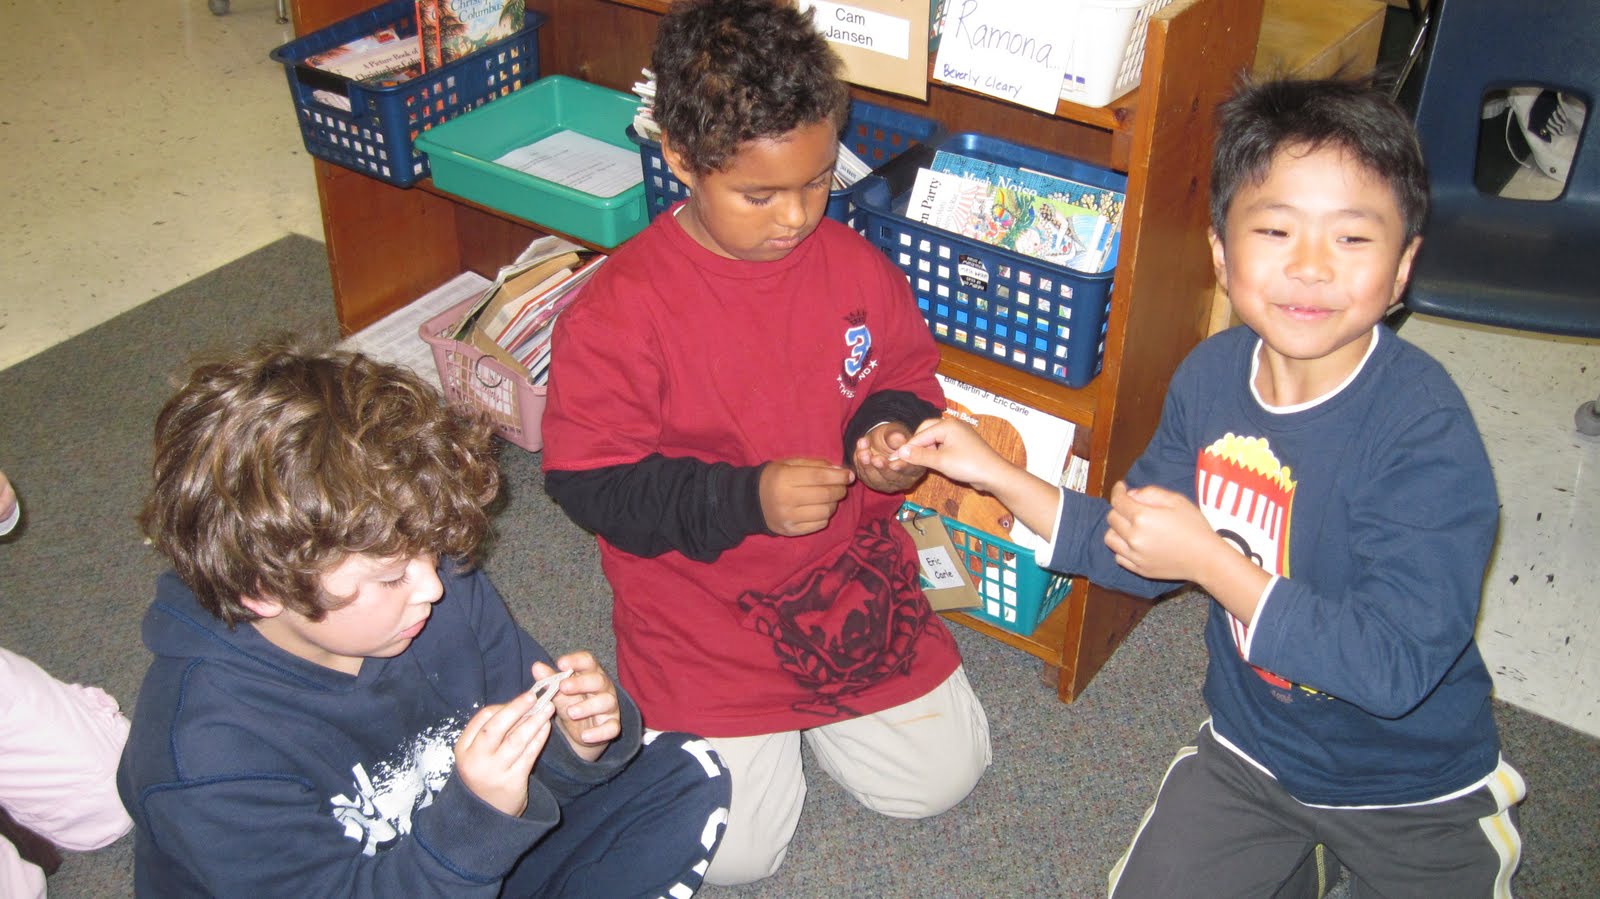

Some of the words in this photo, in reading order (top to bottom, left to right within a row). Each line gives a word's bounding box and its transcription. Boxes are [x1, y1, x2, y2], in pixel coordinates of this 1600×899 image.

[459, 3, 504, 23] Columbus
[835, 7, 866, 26] Cam
[826, 25, 873, 47] Jansen
[368, 56, 393, 68] Picture
[392, 51, 411, 61] Book
[943, 63, 980, 86] Beverly
[985, 76, 1023, 99] Cleary
[920, 177, 942, 210] Party
[962, 171, 992, 186] Much
[997, 175, 1038, 197] Noise
[844, 324, 872, 377] 3
[943, 376, 956, 385] Bill
[957, 381, 981, 396] Martin
[981, 391, 990, 399] Jr
[993, 394, 1008, 408] Eric
[1009, 402, 1030, 416] Carle
[926, 557, 942, 567] Eric
[934, 569, 954, 579] Carle
